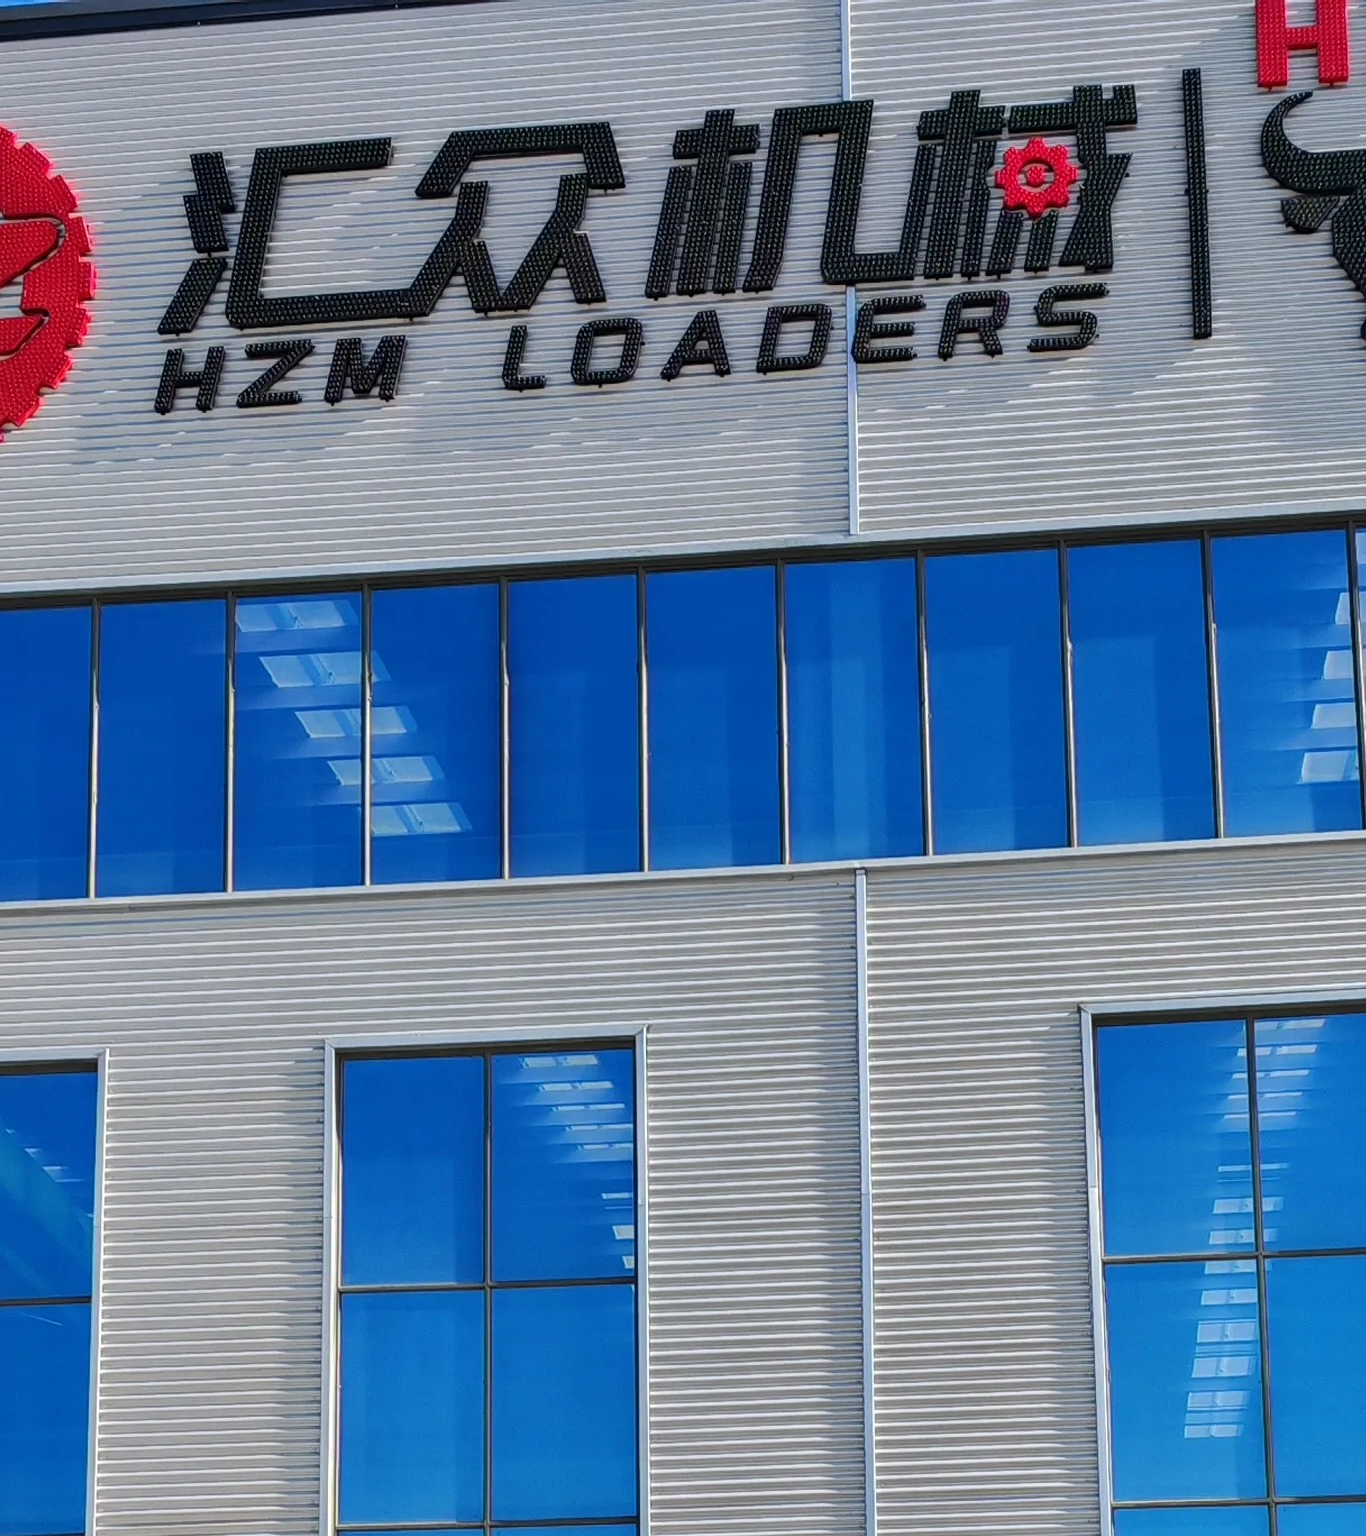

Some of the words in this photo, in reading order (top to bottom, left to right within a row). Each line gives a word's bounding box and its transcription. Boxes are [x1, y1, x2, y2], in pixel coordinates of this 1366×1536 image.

[156, 84, 1138, 334] 汇众机械
[152, 335, 408, 414] HZM
[499, 282, 1111, 392] LOADERS
